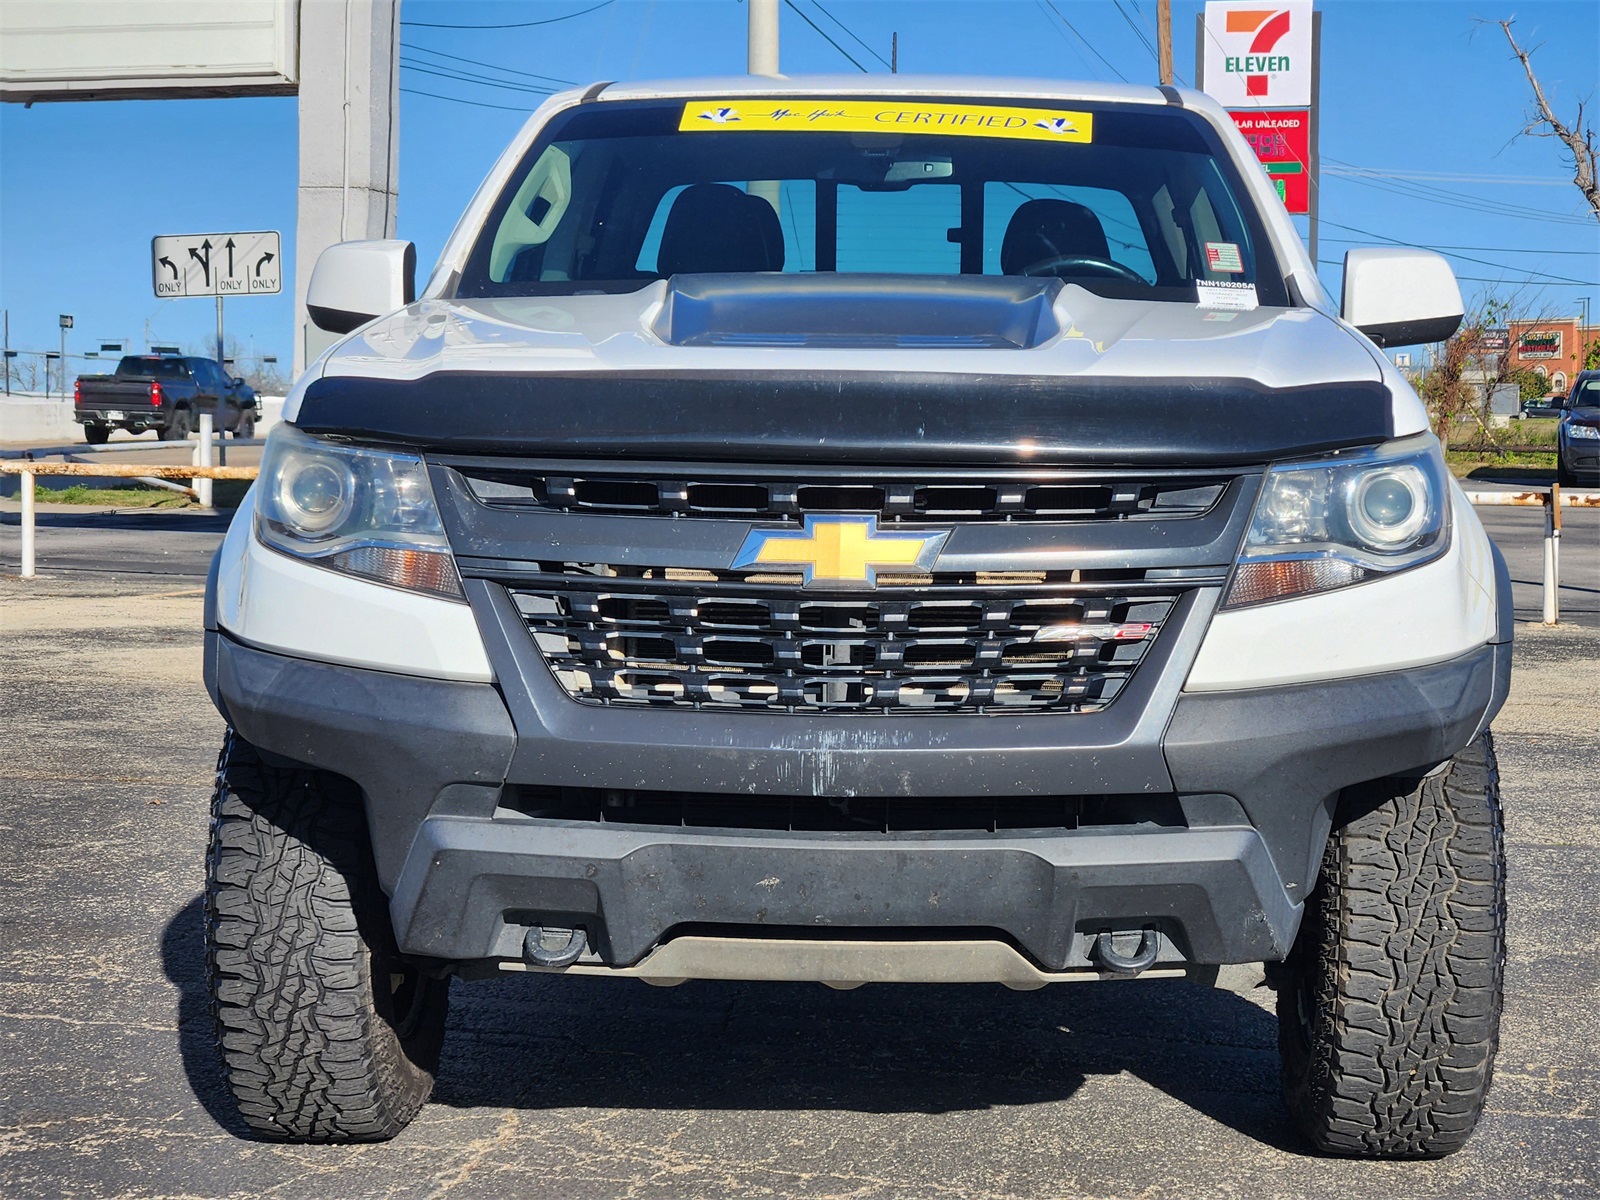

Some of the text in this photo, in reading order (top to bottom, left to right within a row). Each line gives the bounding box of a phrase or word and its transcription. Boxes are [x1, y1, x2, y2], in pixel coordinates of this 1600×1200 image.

[875, 111, 1028, 128] CERTIFIED
[1255, 120, 1300, 128] UNLEADED
[158, 282, 182, 292] ONLY
[220, 280, 242, 290] ONLY
[252, 279, 277, 289] ONLY
